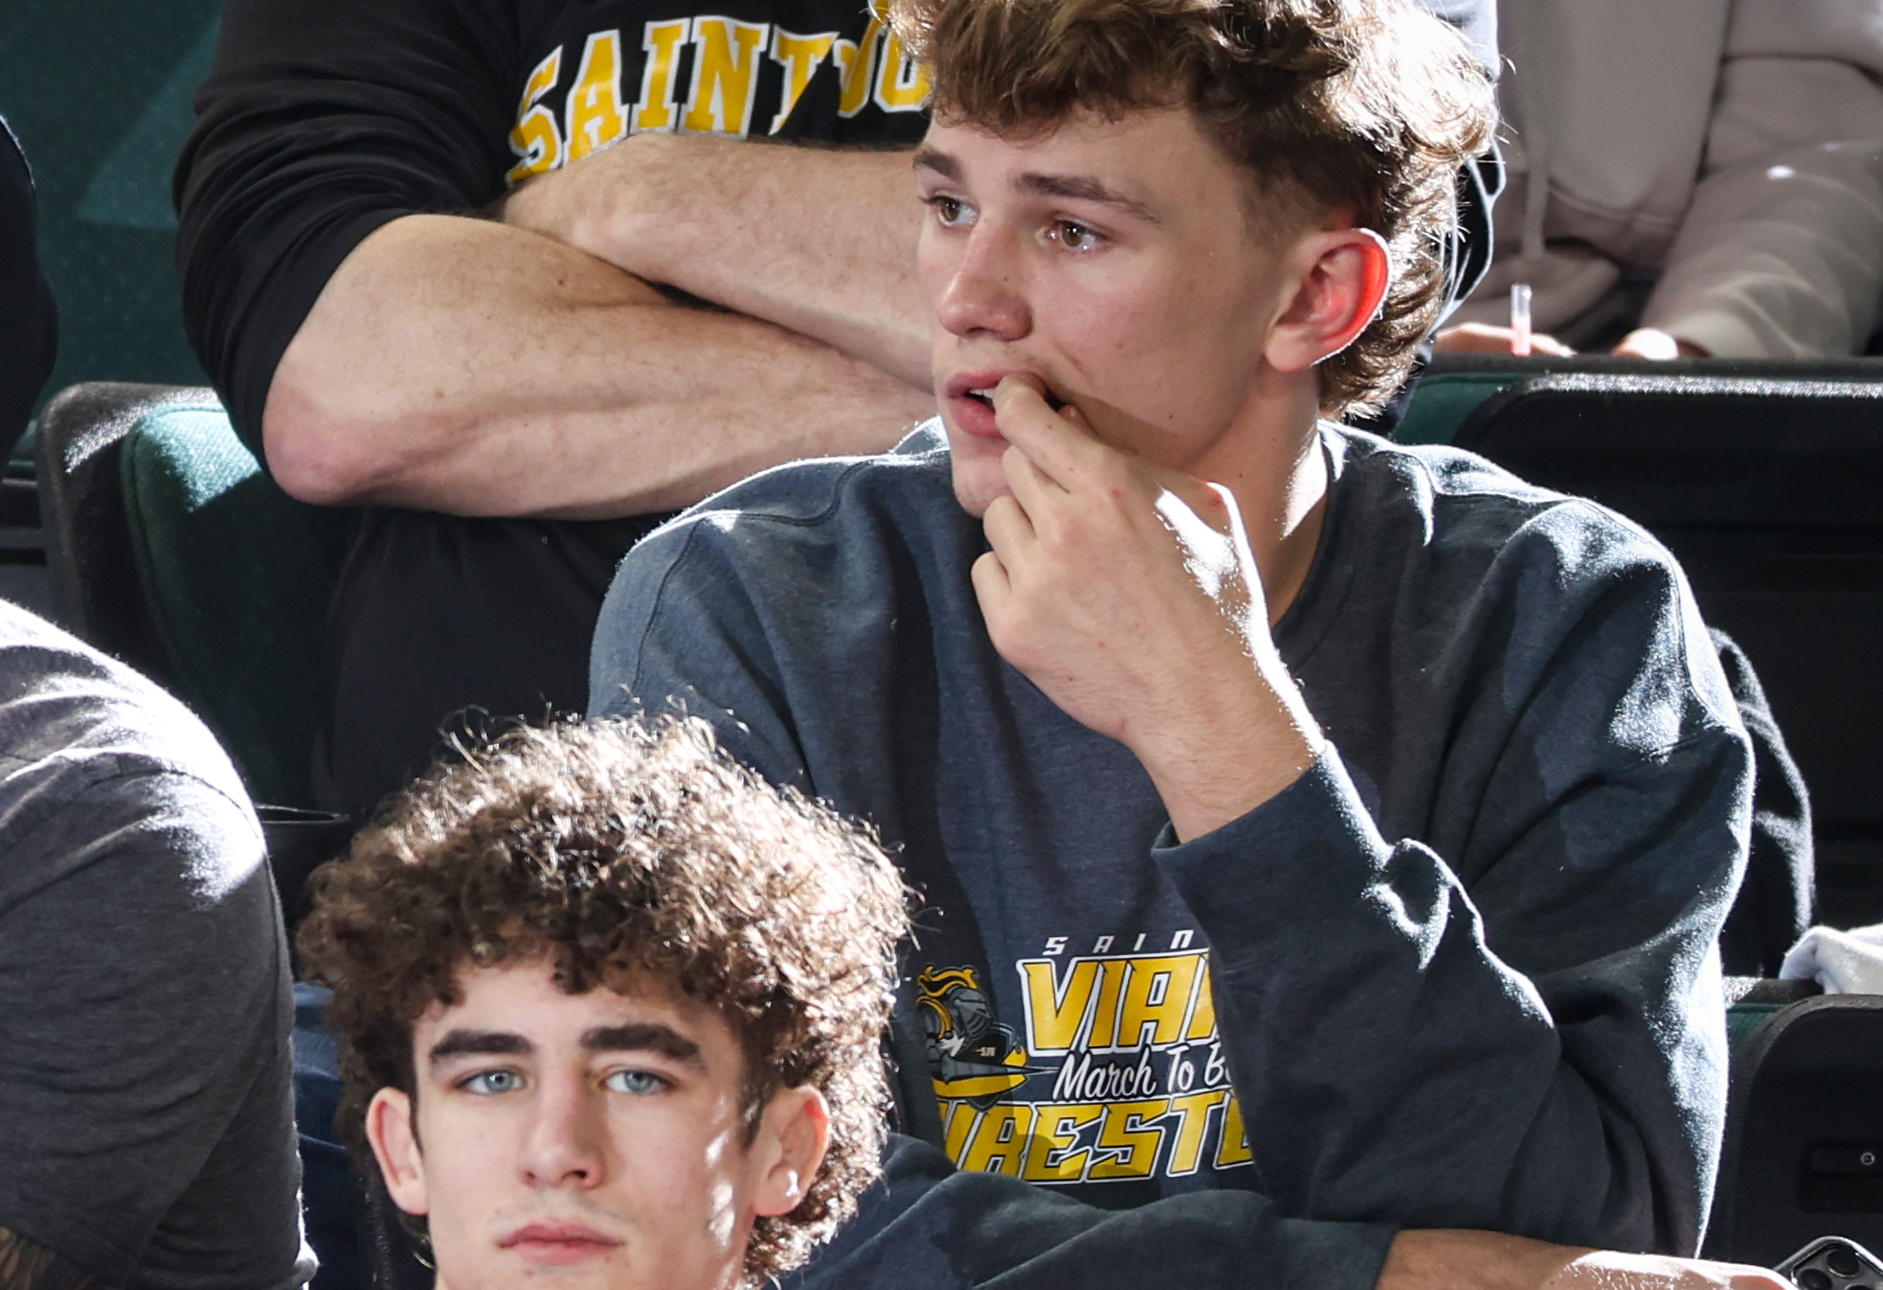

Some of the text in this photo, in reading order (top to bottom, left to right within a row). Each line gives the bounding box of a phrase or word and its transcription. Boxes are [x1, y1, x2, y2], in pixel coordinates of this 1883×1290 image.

[505, 15, 839, 185] SAINT
[1053, 1047, 1157, 1099] March
[1167, 1045, 1194, 1092] To
